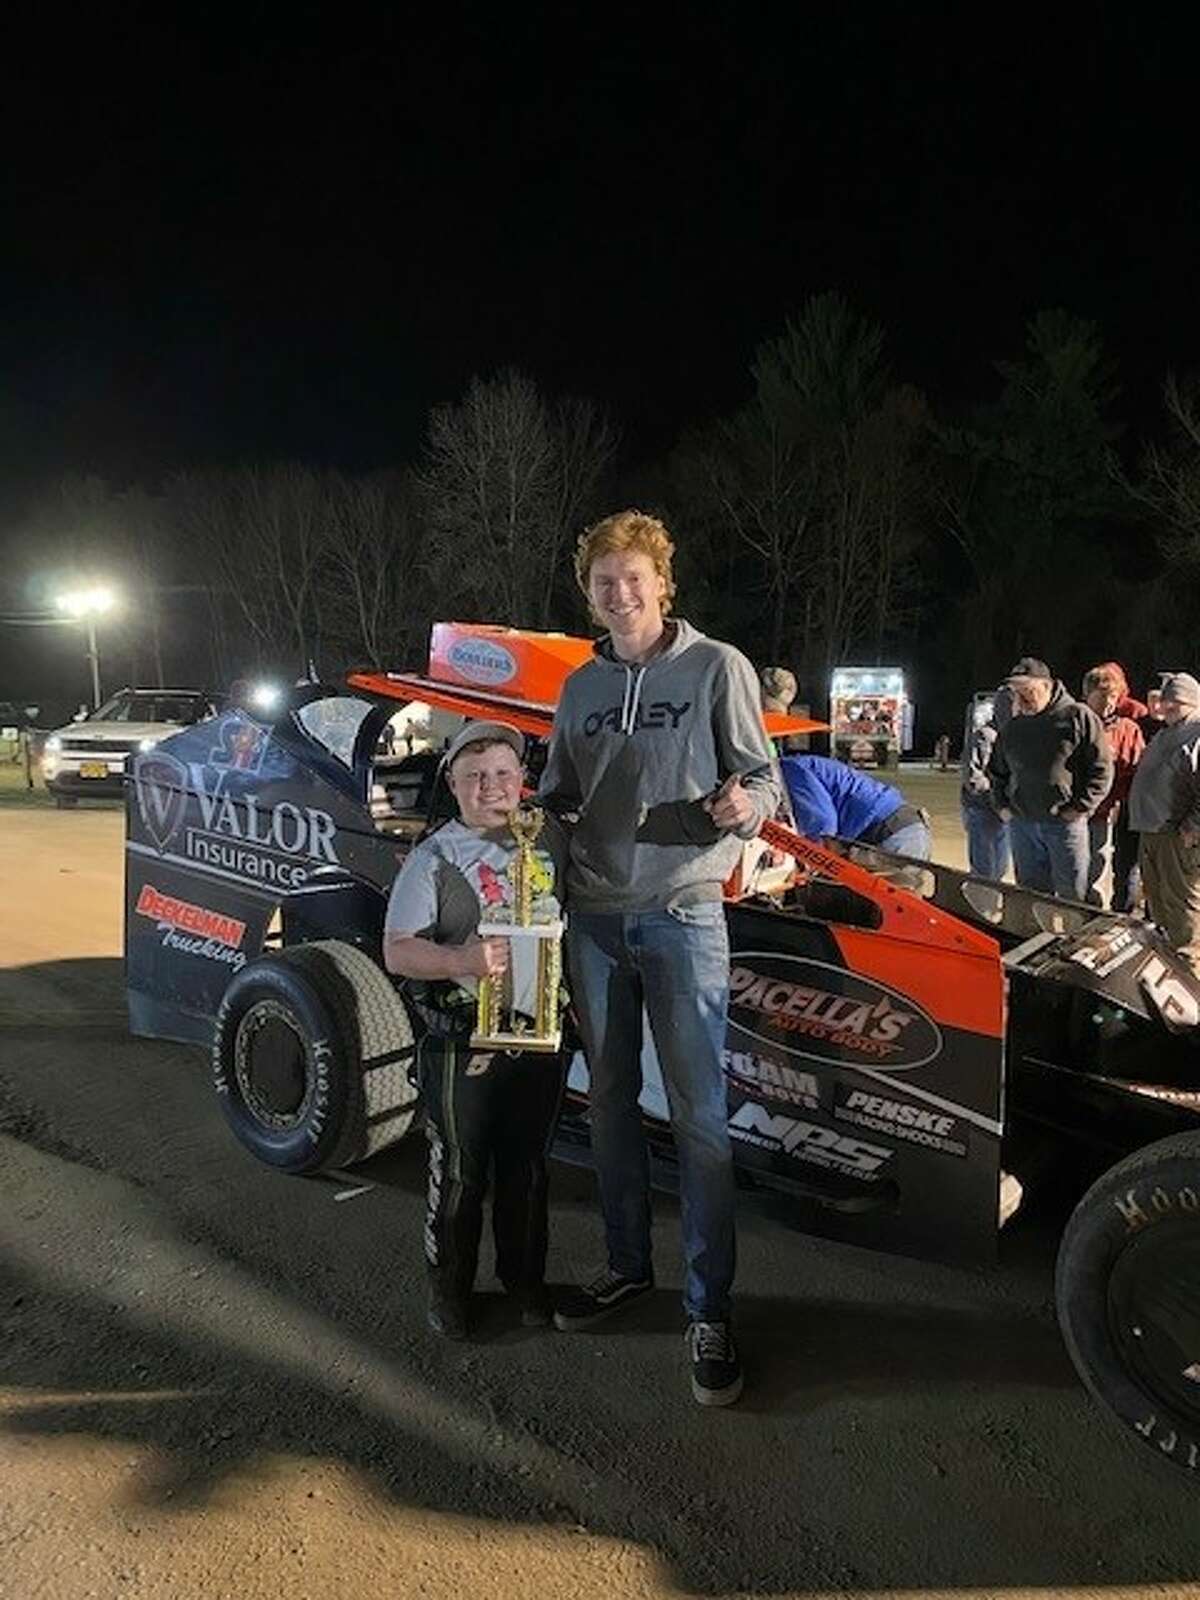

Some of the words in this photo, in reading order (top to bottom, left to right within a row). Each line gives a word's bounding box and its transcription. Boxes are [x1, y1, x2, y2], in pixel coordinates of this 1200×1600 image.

[189, 762, 340, 864] VALOR
[185, 831, 307, 887] Insurance
[730, 967, 911, 1041] PACELLA'S
[845, 1091, 956, 1137] PENSKE
